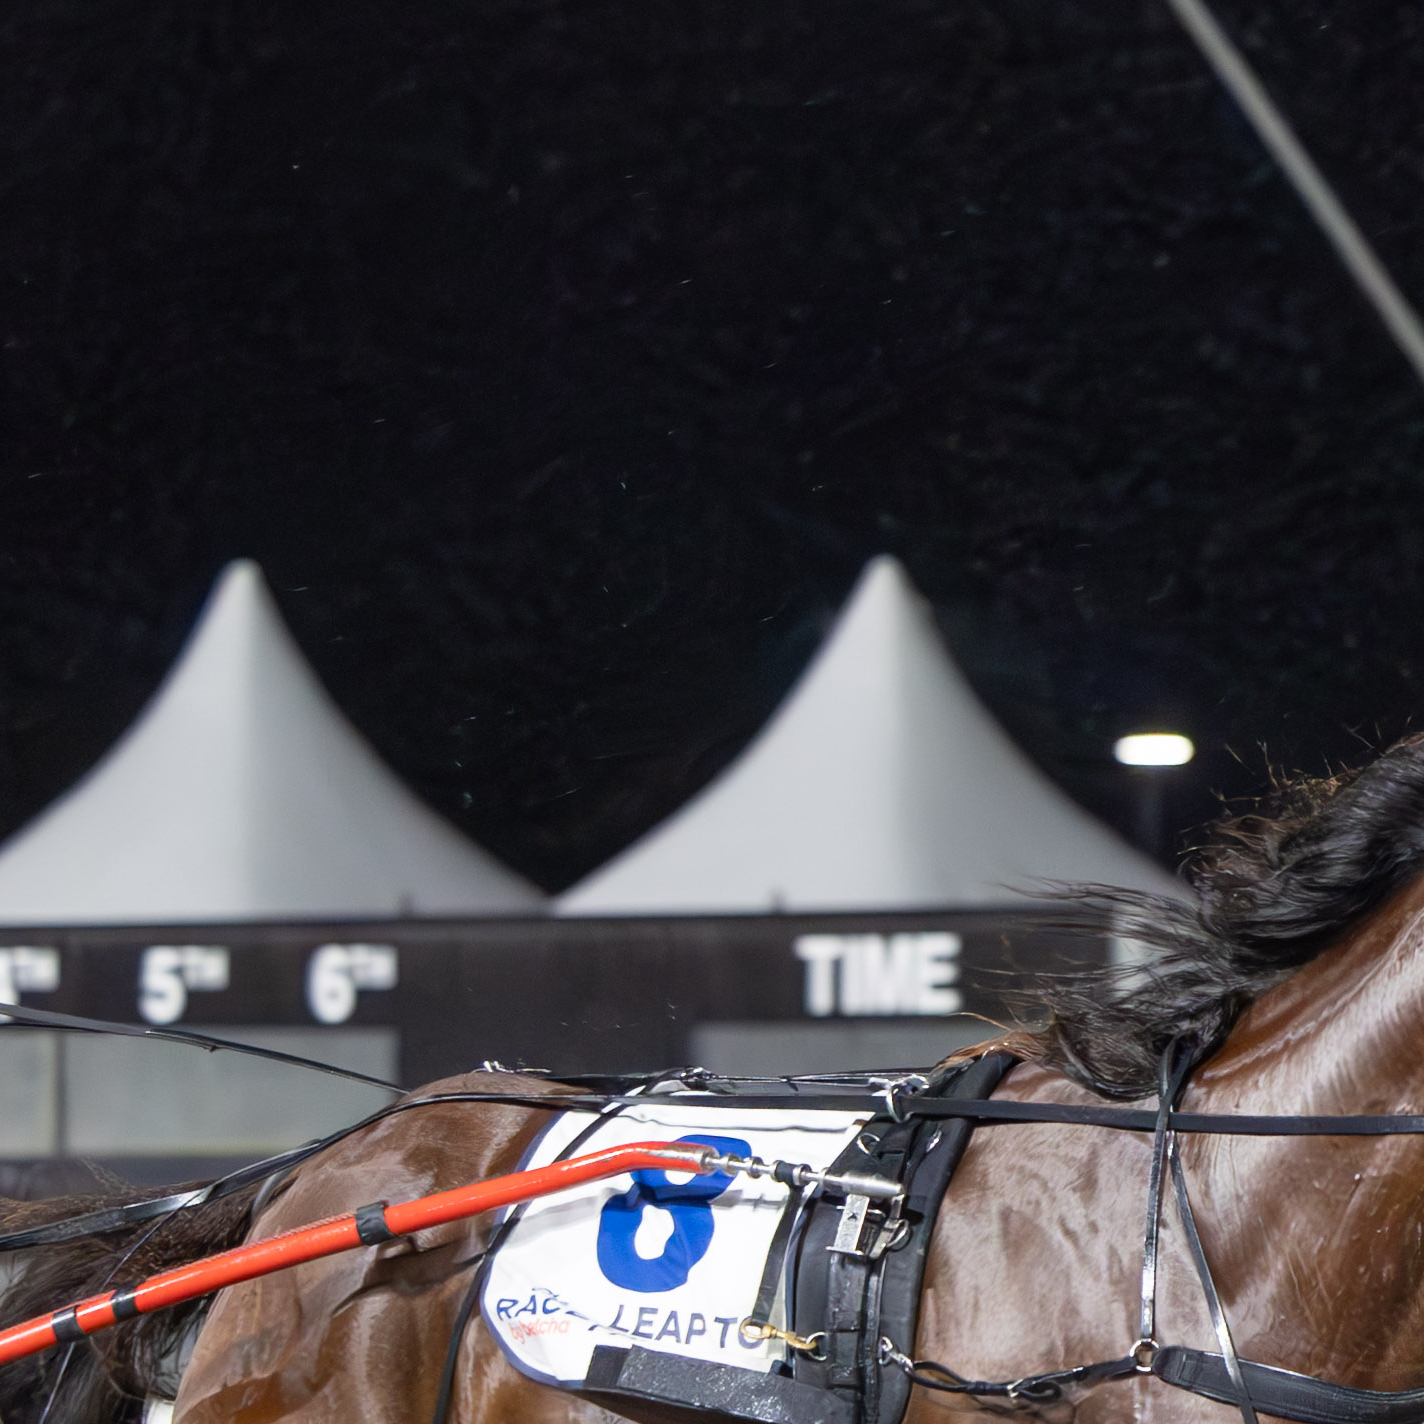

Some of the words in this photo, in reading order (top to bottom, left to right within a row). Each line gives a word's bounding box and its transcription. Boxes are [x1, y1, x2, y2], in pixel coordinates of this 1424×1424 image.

[793, 933, 963, 1017] TIME
[597, 1134, 752, 1293] 8
[496, 1294, 567, 1322] RAC
[609, 1304, 706, 1344] LEAP
